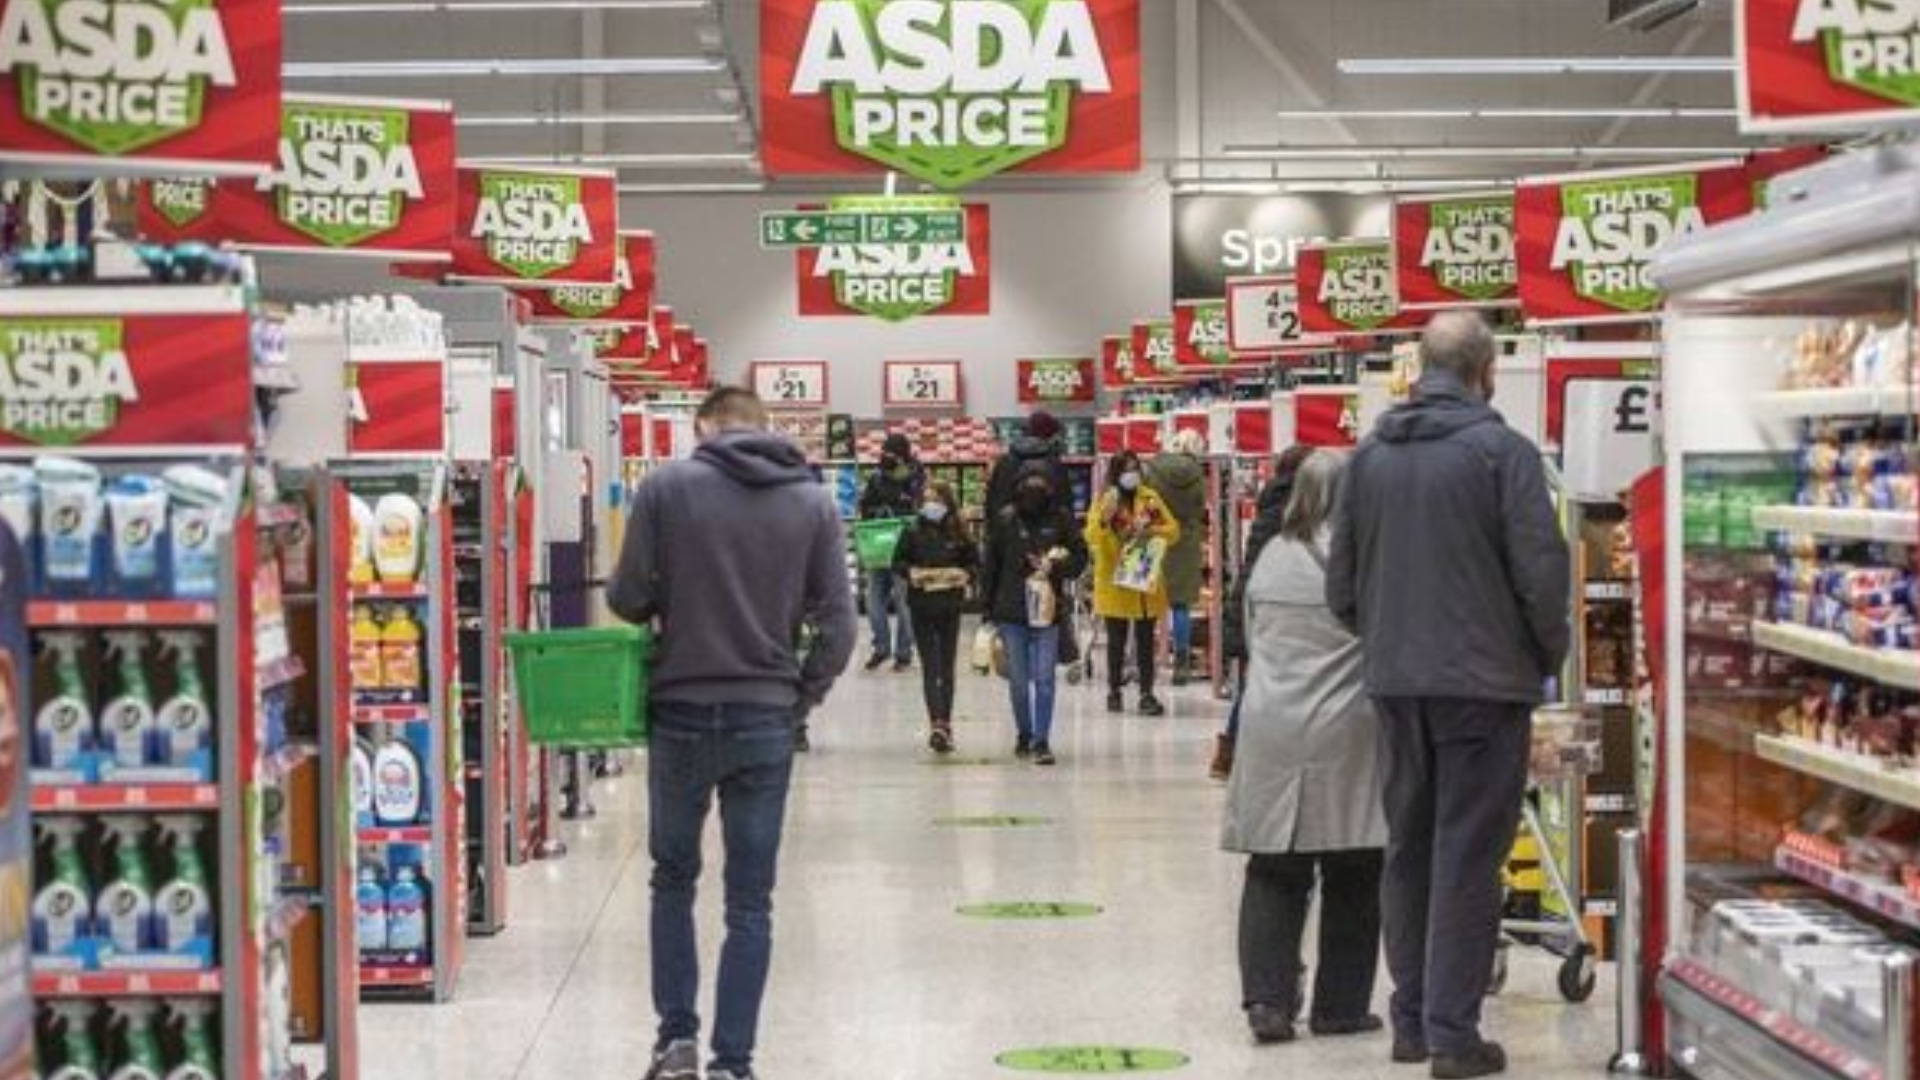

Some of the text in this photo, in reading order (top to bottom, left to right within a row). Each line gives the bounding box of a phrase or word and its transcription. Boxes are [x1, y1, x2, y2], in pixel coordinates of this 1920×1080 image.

[0, 0, 237, 86] ASDA
[790, 0, 1112, 93] ASDA
[36, 78, 188, 126] PRICE
[292, 115, 386, 142] THAT'S
[854, 98, 1048, 147] PRICE
[256, 139, 424, 198] ASDA
[287, 194, 390, 226] PRICE
[1583, 187, 1675, 214] THAT'S
[471, 197, 593, 243] ASDA
[494, 239, 570, 263] PRICE
[812, 243, 975, 276] ASDA
[1221, 229, 1327, 275] Spr
[845, 278, 944, 303] PRICE
[1444, 264, 1517, 287] PRICE
[1265, 289, 1280, 309] 4
[4, 401, 105, 431] PRICE
